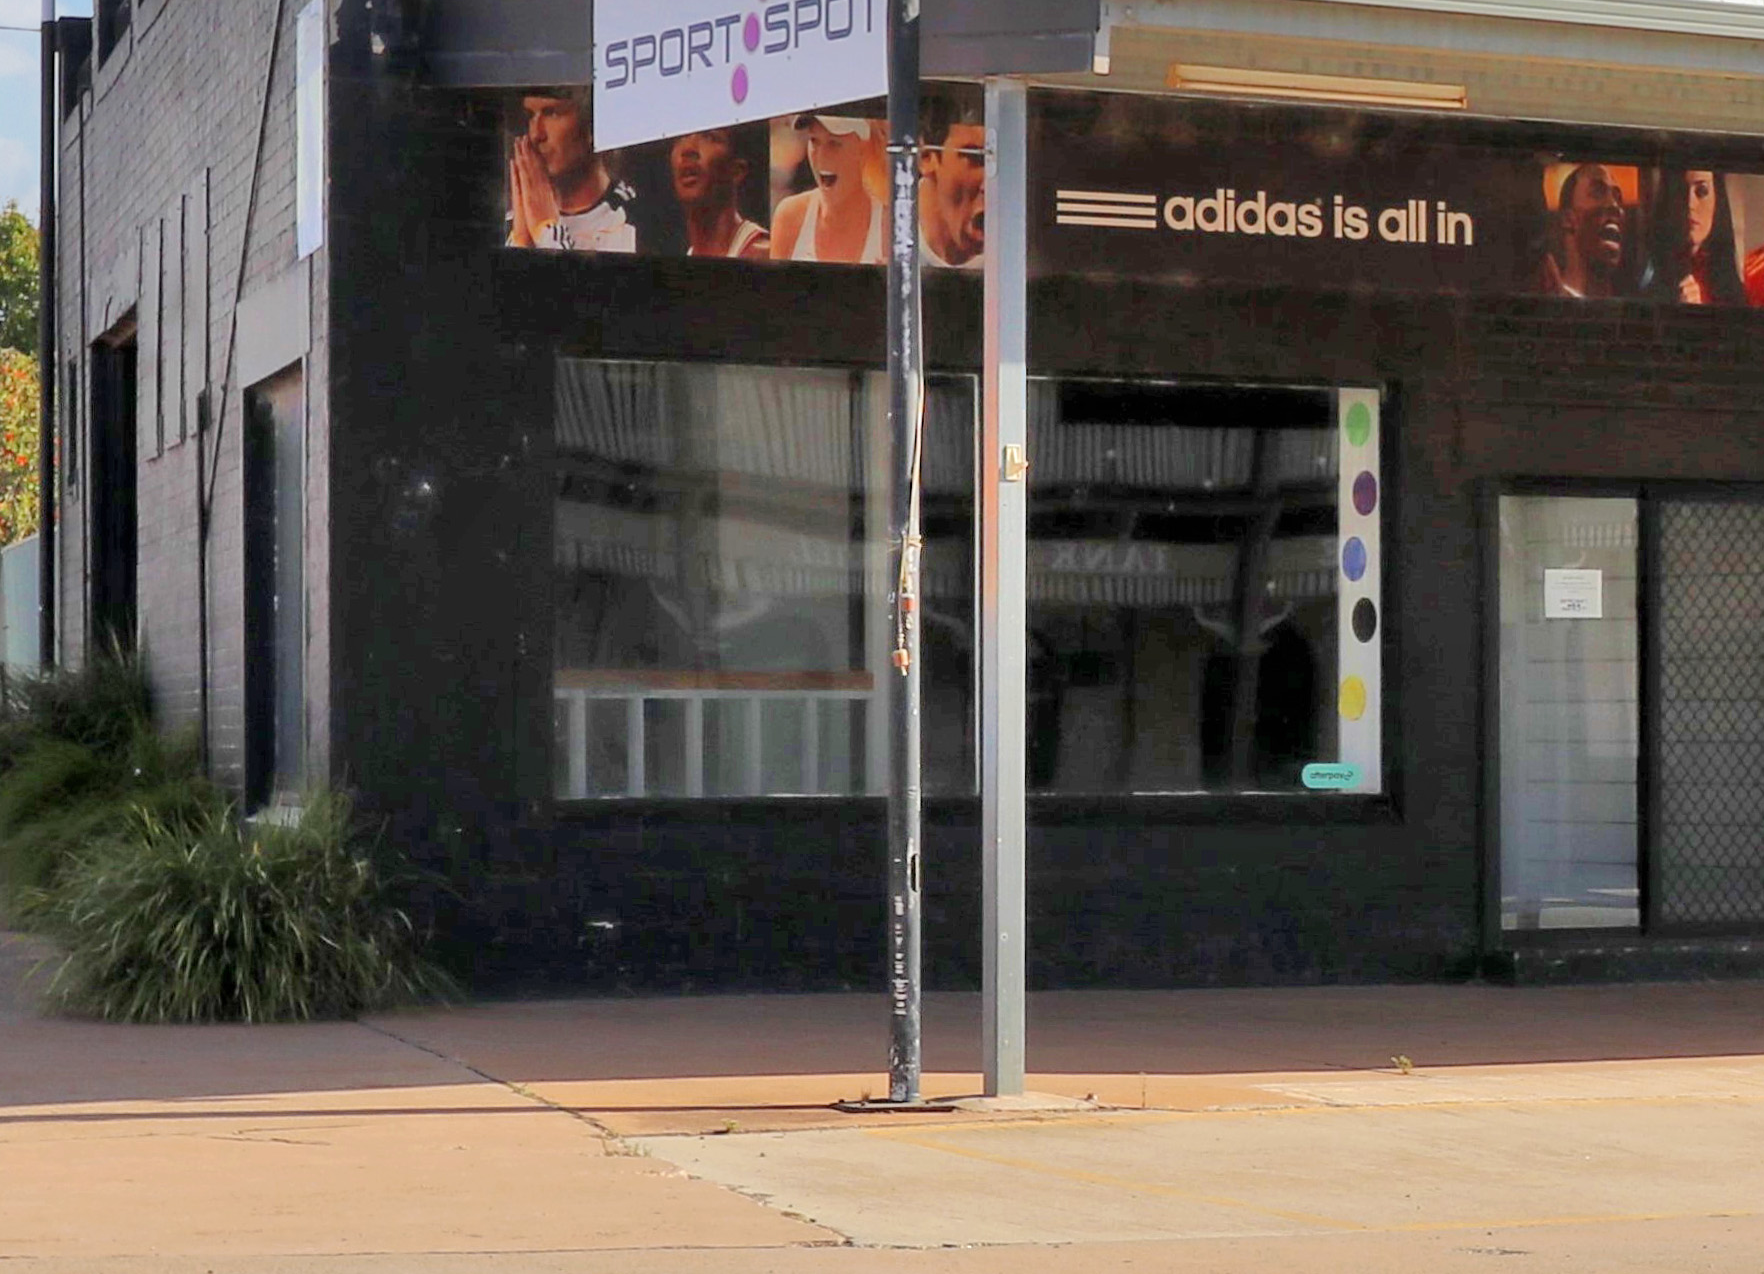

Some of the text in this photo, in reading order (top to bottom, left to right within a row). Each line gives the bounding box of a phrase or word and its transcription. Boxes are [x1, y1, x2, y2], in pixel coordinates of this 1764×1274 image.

[605, 13, 742, 90] SPORT
[1164, 188, 1474, 246] adidas is all in
